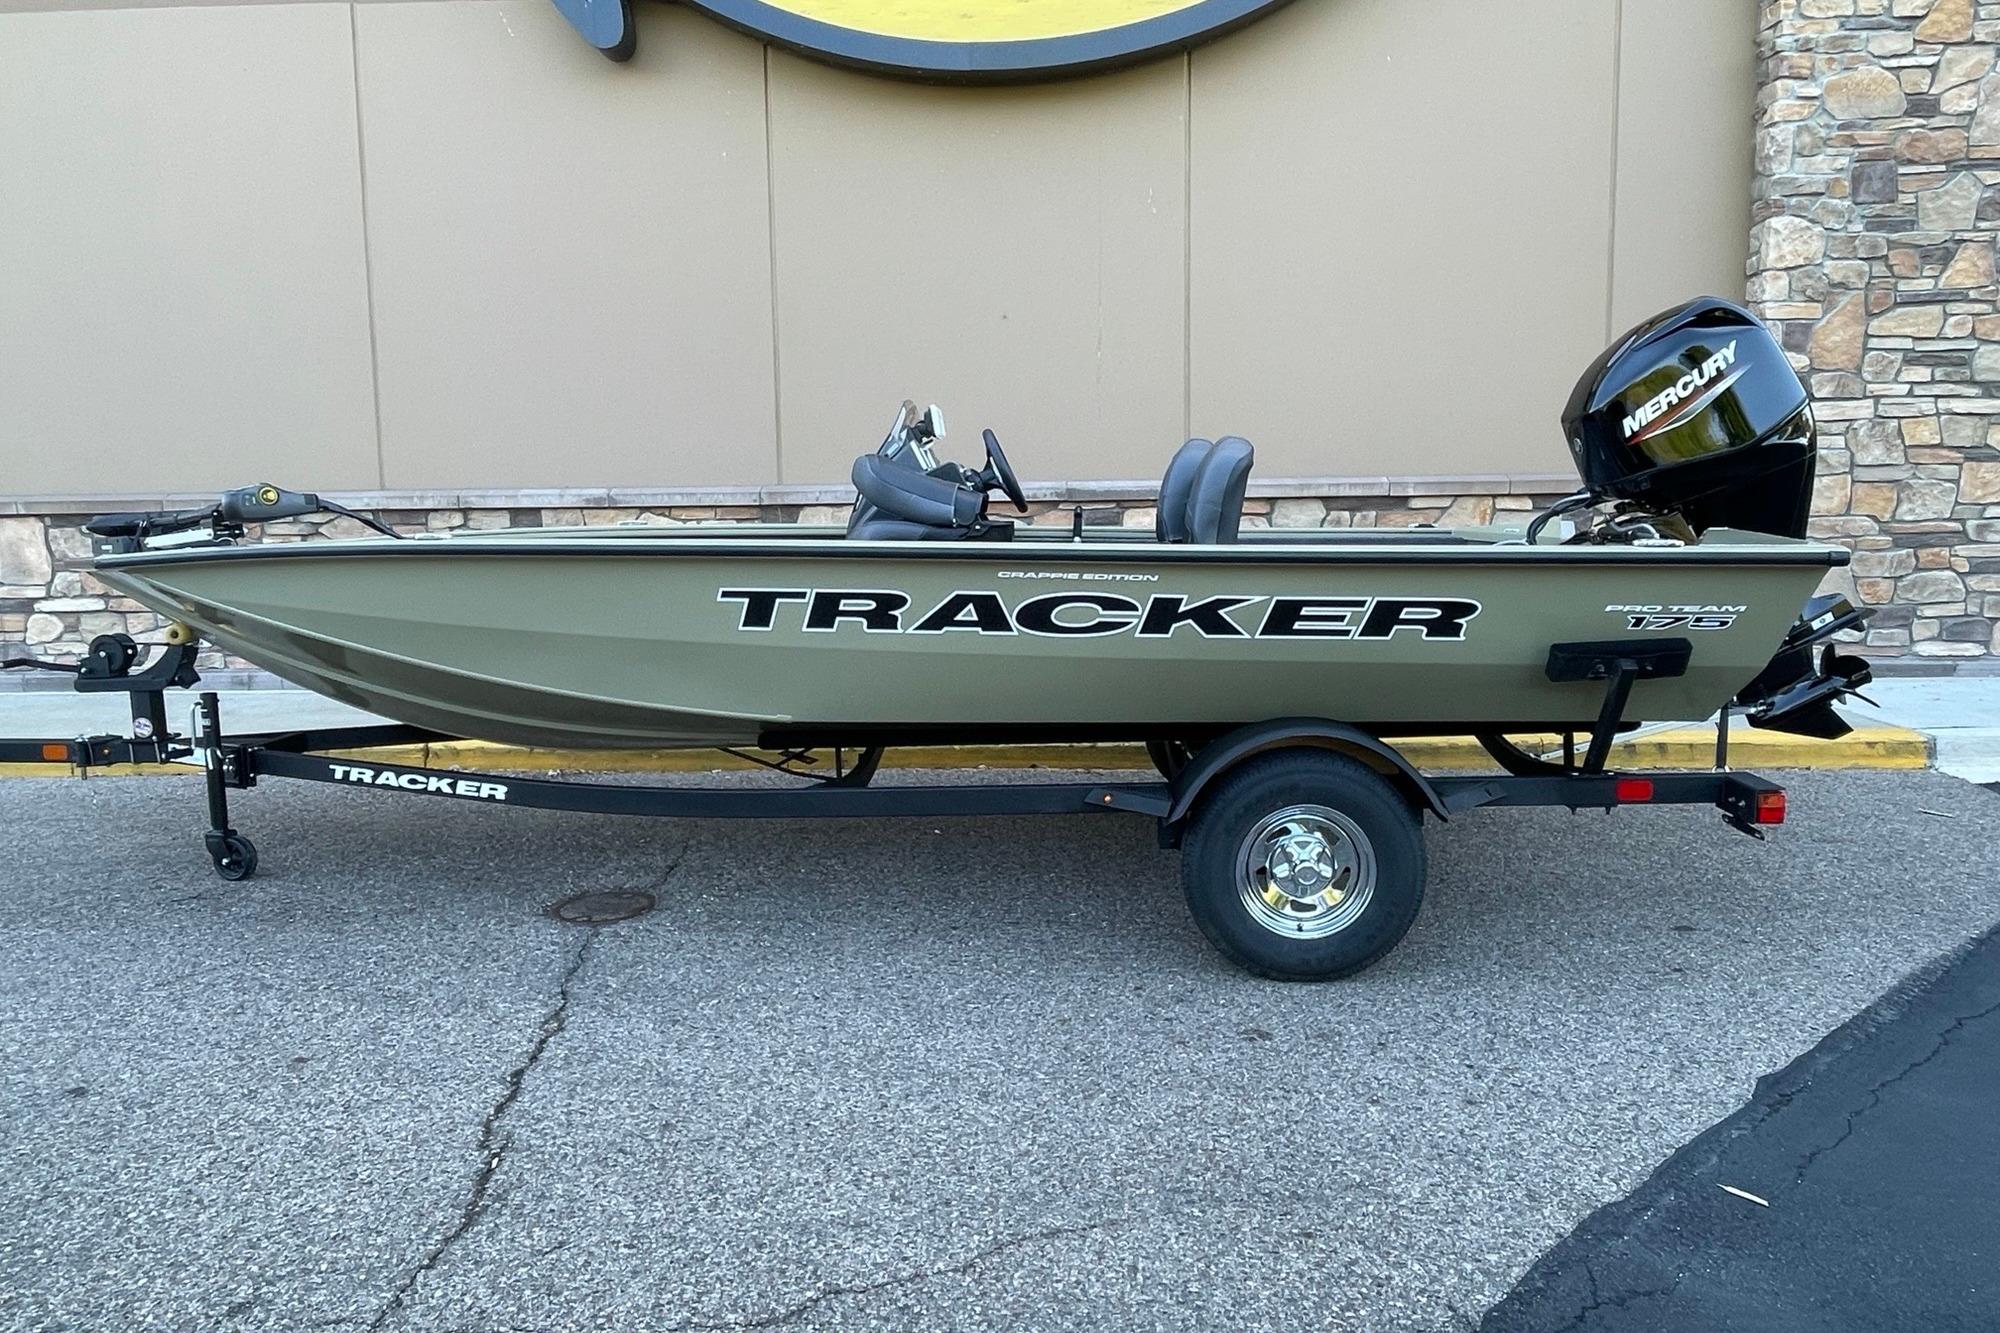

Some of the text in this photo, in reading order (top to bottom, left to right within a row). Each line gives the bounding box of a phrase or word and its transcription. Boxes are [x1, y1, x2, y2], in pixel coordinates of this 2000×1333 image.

[1622, 339, 1737, 438] MERCURY
[997, 571, 1159, 582] CRAPPIE EDITION
[717, 587, 1482, 641] TRACKER
[1604, 604, 1748, 613] PRO TEAM
[1626, 614, 1738, 631] 175
[328, 764, 509, 800] TRACKER
